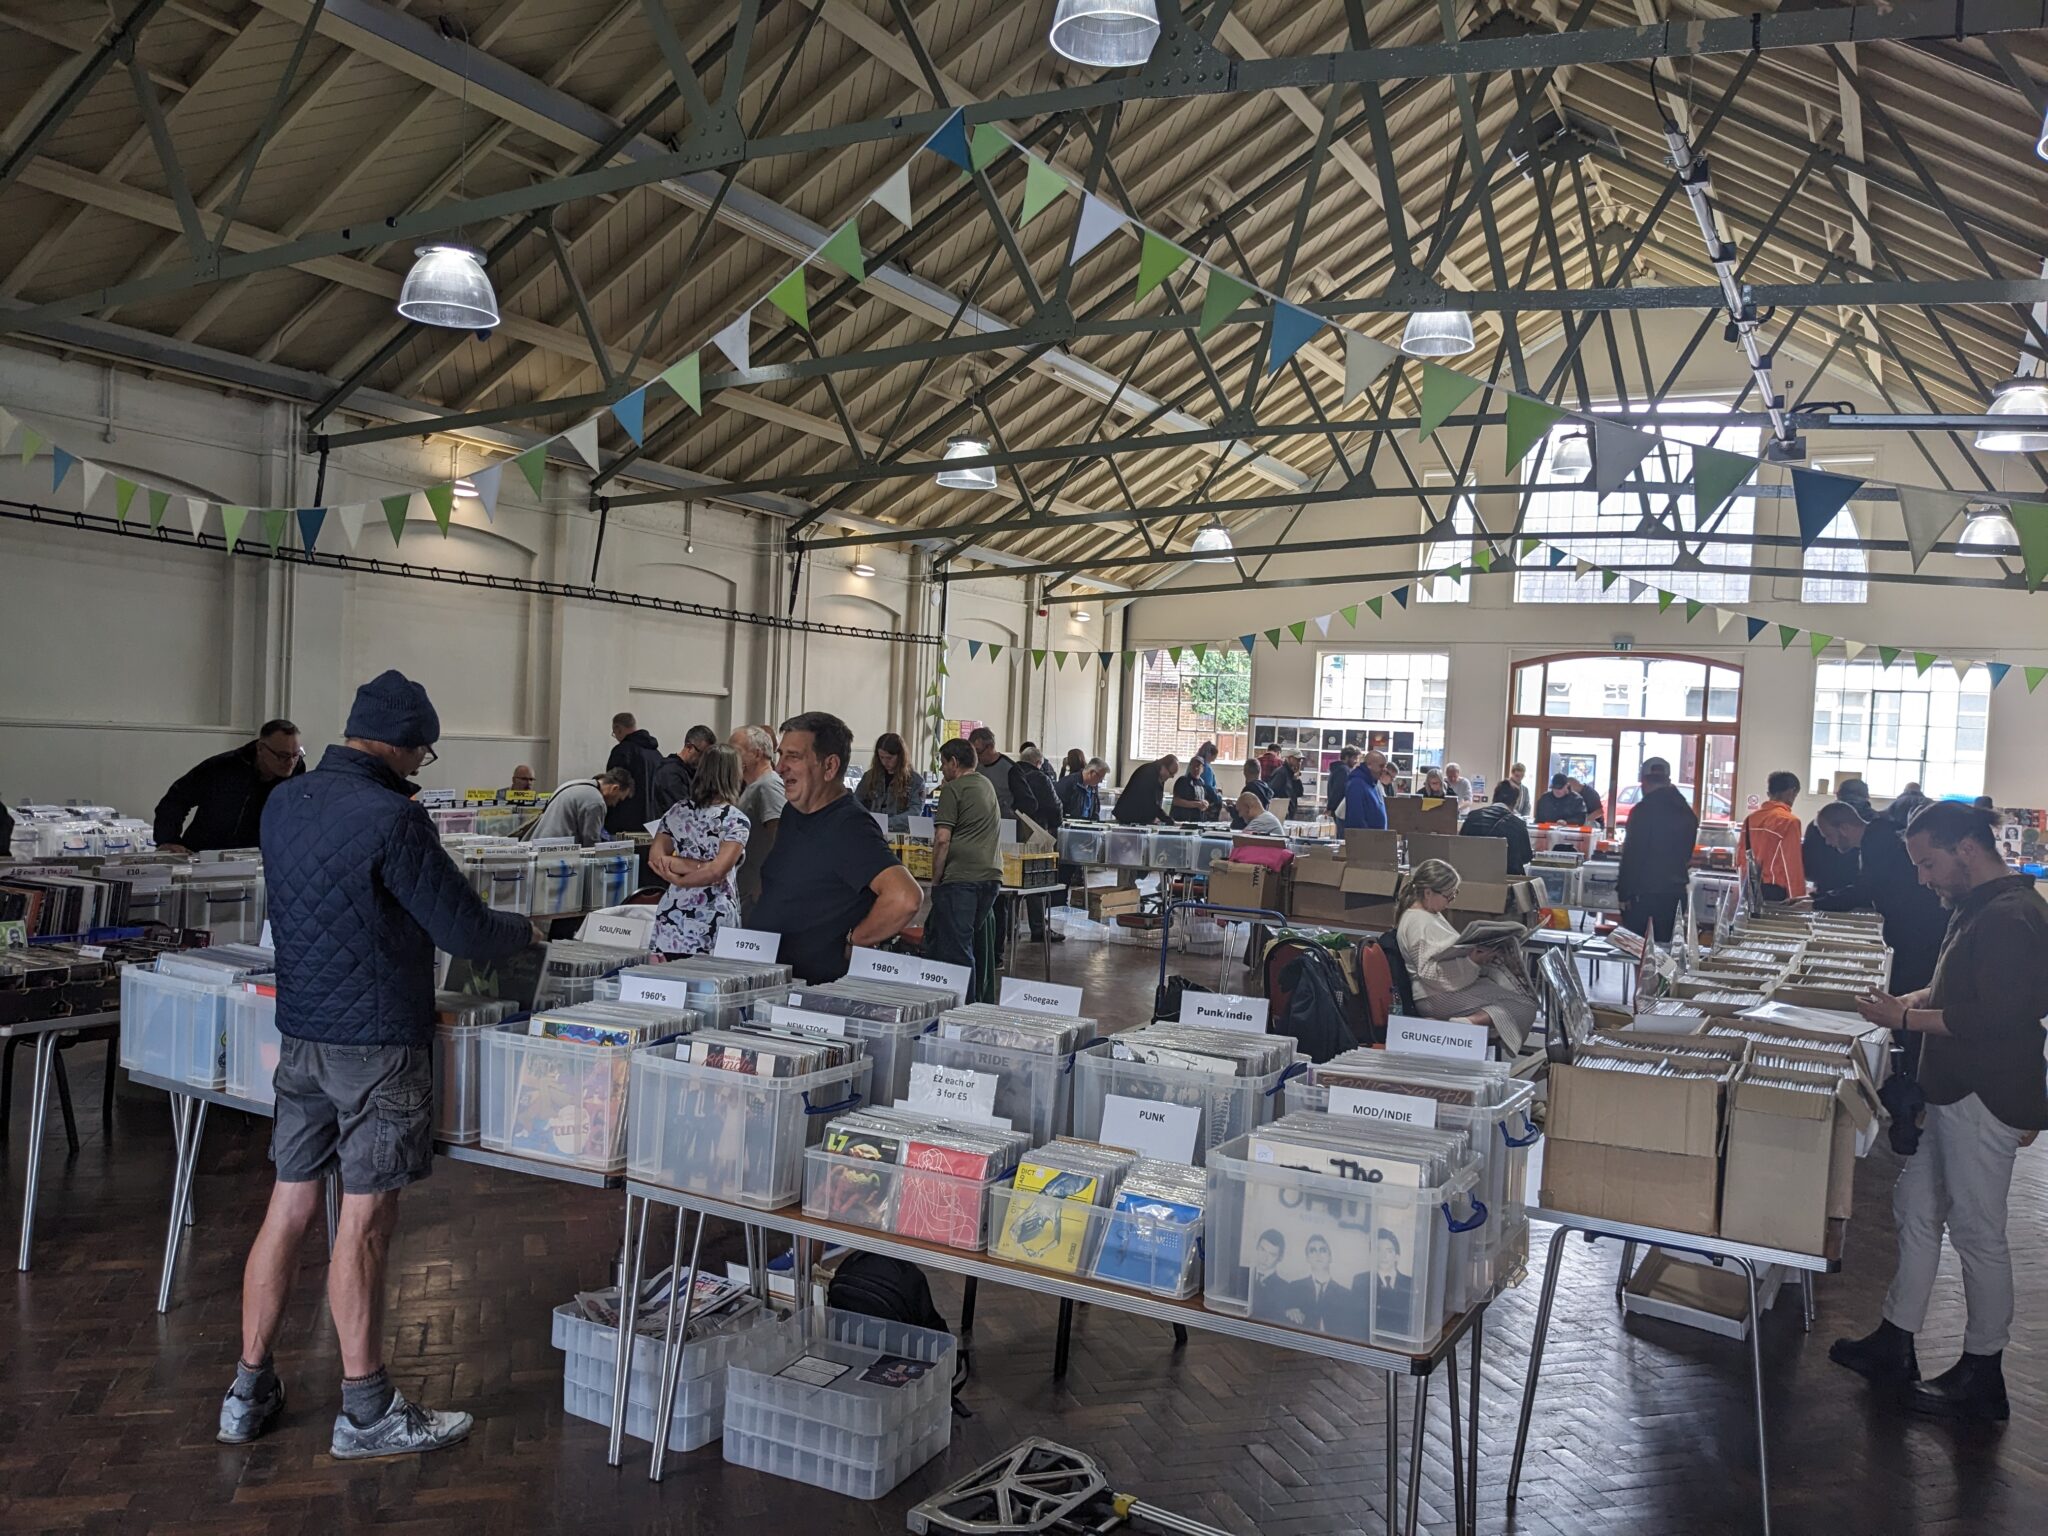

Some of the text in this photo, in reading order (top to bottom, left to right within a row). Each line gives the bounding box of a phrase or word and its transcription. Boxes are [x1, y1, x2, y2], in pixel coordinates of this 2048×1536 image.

[598, 924, 632, 937] SOUL/FUNK
[735, 940, 760, 951] 1970's
[871, 962, 948, 985] 1980's 1990's
[640, 991, 666, 1002] 1960's
[1023, 993, 1059, 1006] Shoegaze
[1401, 1031, 1473, 1048] GRUNGE/INDIE
[978, 1052, 1010, 1067] RIDE
[933, 1074, 975, 1089] £2 each or
[936, 1088, 968, 1101] 3 for £5
[1139, 1110, 1166, 1123] PUNK
[1352, 1104, 1413, 1122] MOD/INDIE
[827, 1133, 850, 1154] L7
